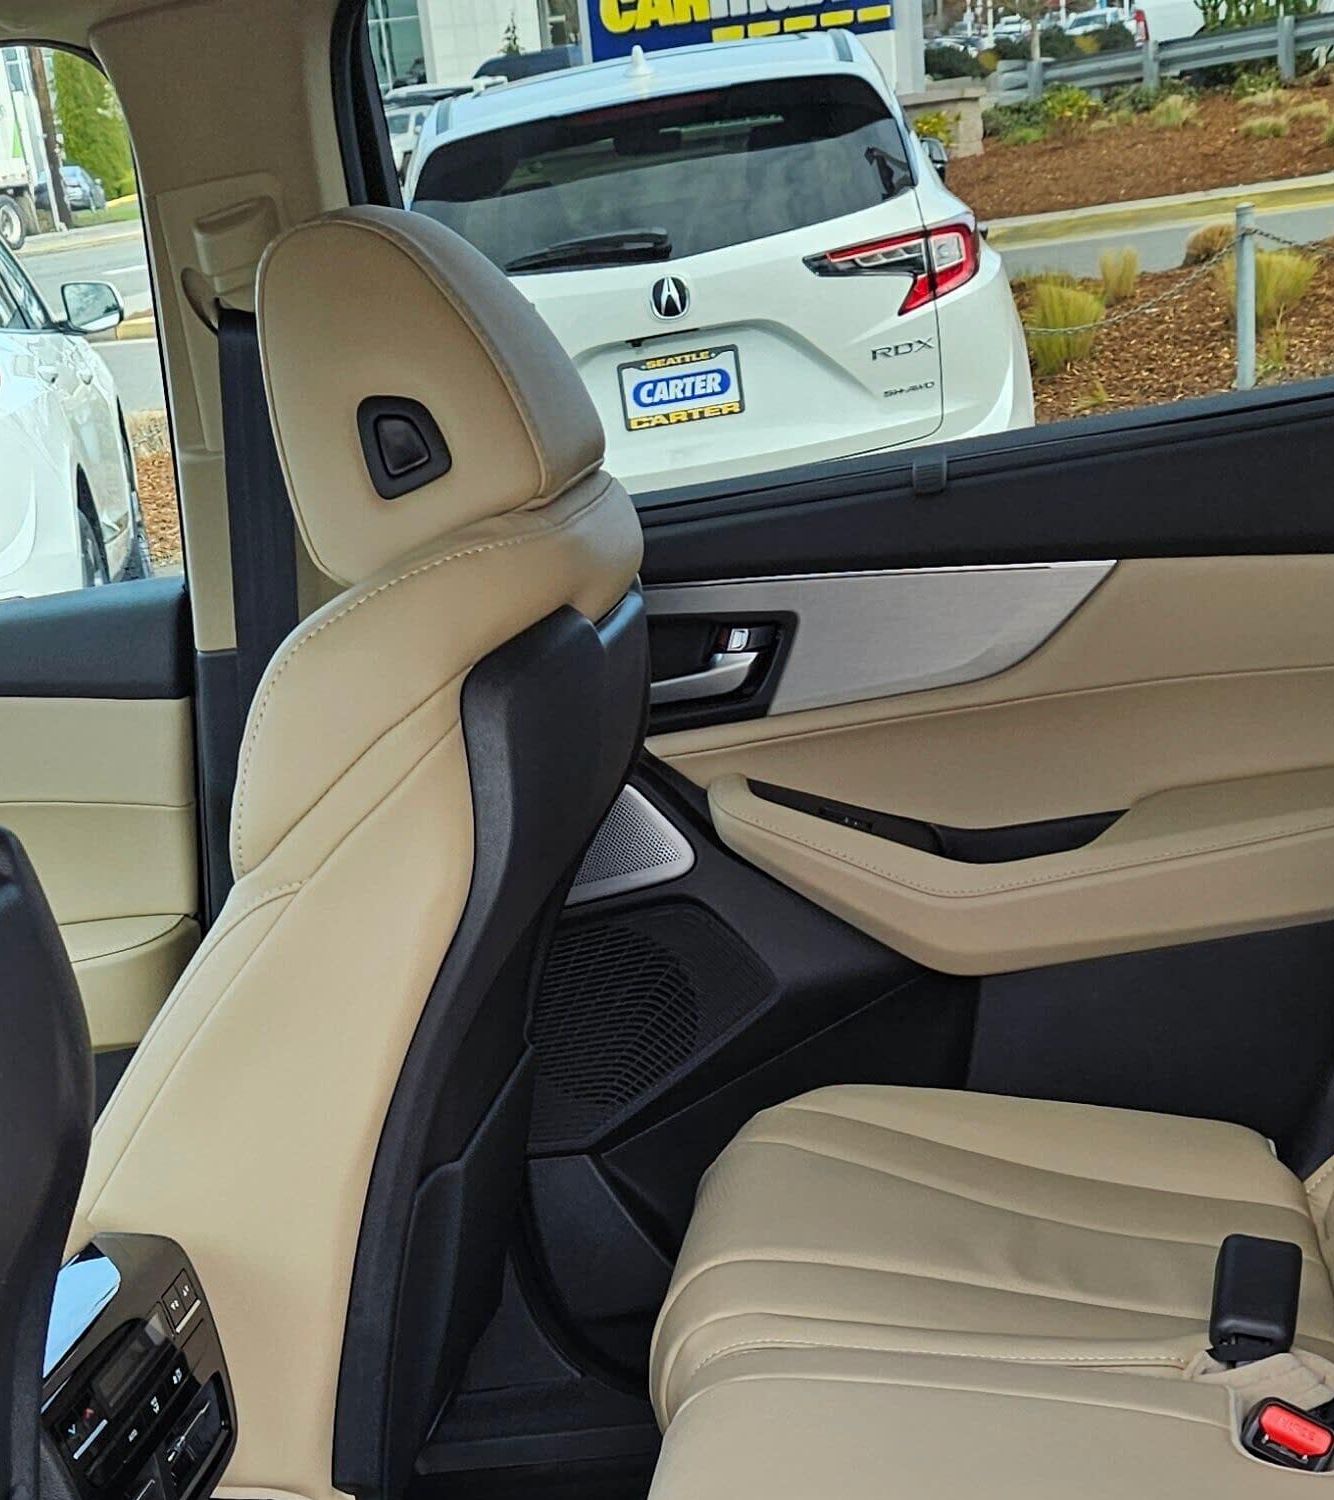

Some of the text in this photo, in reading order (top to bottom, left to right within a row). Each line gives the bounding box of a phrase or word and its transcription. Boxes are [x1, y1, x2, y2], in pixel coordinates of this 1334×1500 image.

[645, 350, 710, 369] SEATTLE
[871, 336, 935, 361] RDX
[639, 372, 722, 404] CARTER
[630, 401, 741, 430] CARTER
